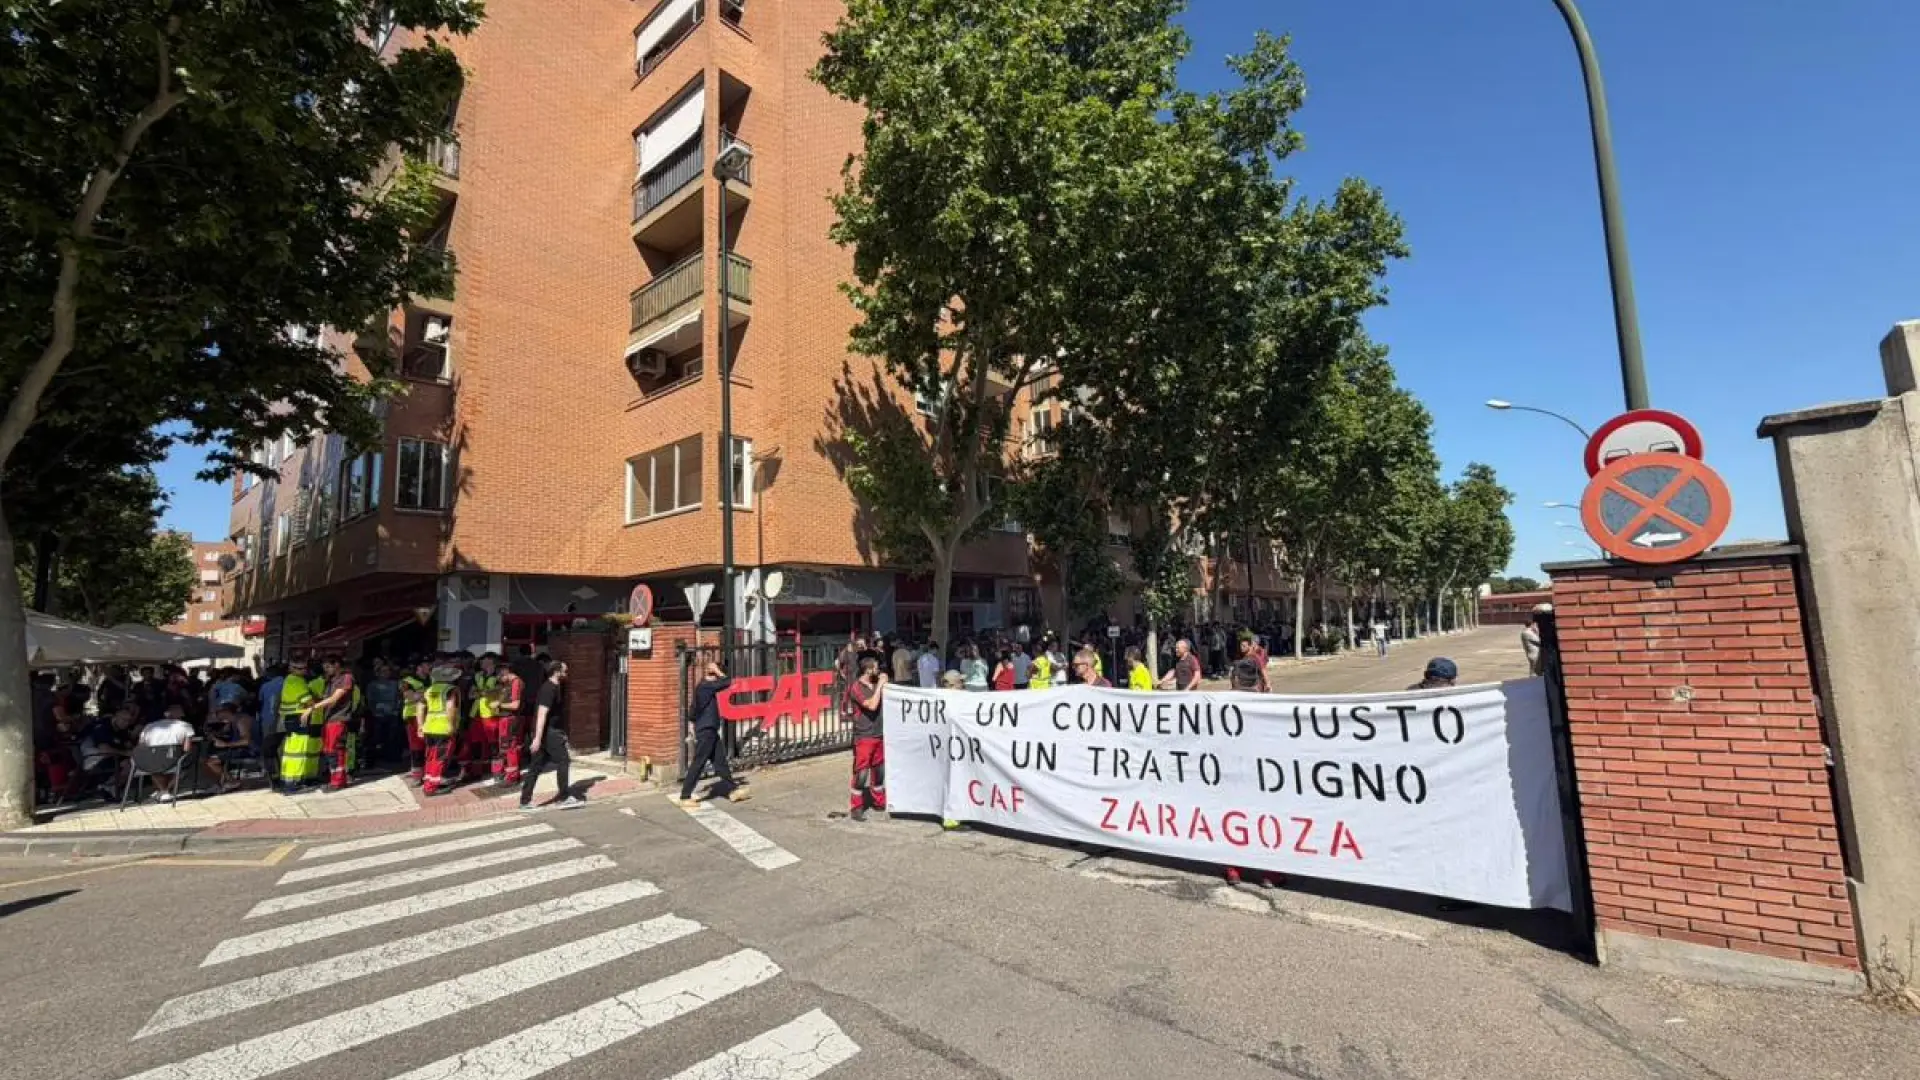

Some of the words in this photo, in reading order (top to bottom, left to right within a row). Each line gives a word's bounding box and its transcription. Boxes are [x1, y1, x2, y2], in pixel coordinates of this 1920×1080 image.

[716, 670, 833, 730] CAF
[901, 699, 946, 724] POR
[976, 702, 1018, 727] UN
[1052, 702, 1244, 736] CONVENIO
[1288, 706, 1465, 744] JUSTO
[929, 734, 985, 763] POR
[1012, 741, 1057, 771] UN
[1088, 747, 1220, 786] TRATO
[1257, 757, 1427, 804] DIGNO
[968, 781, 1025, 812] CAF
[1101, 798, 1363, 860] ZARAGOZA
